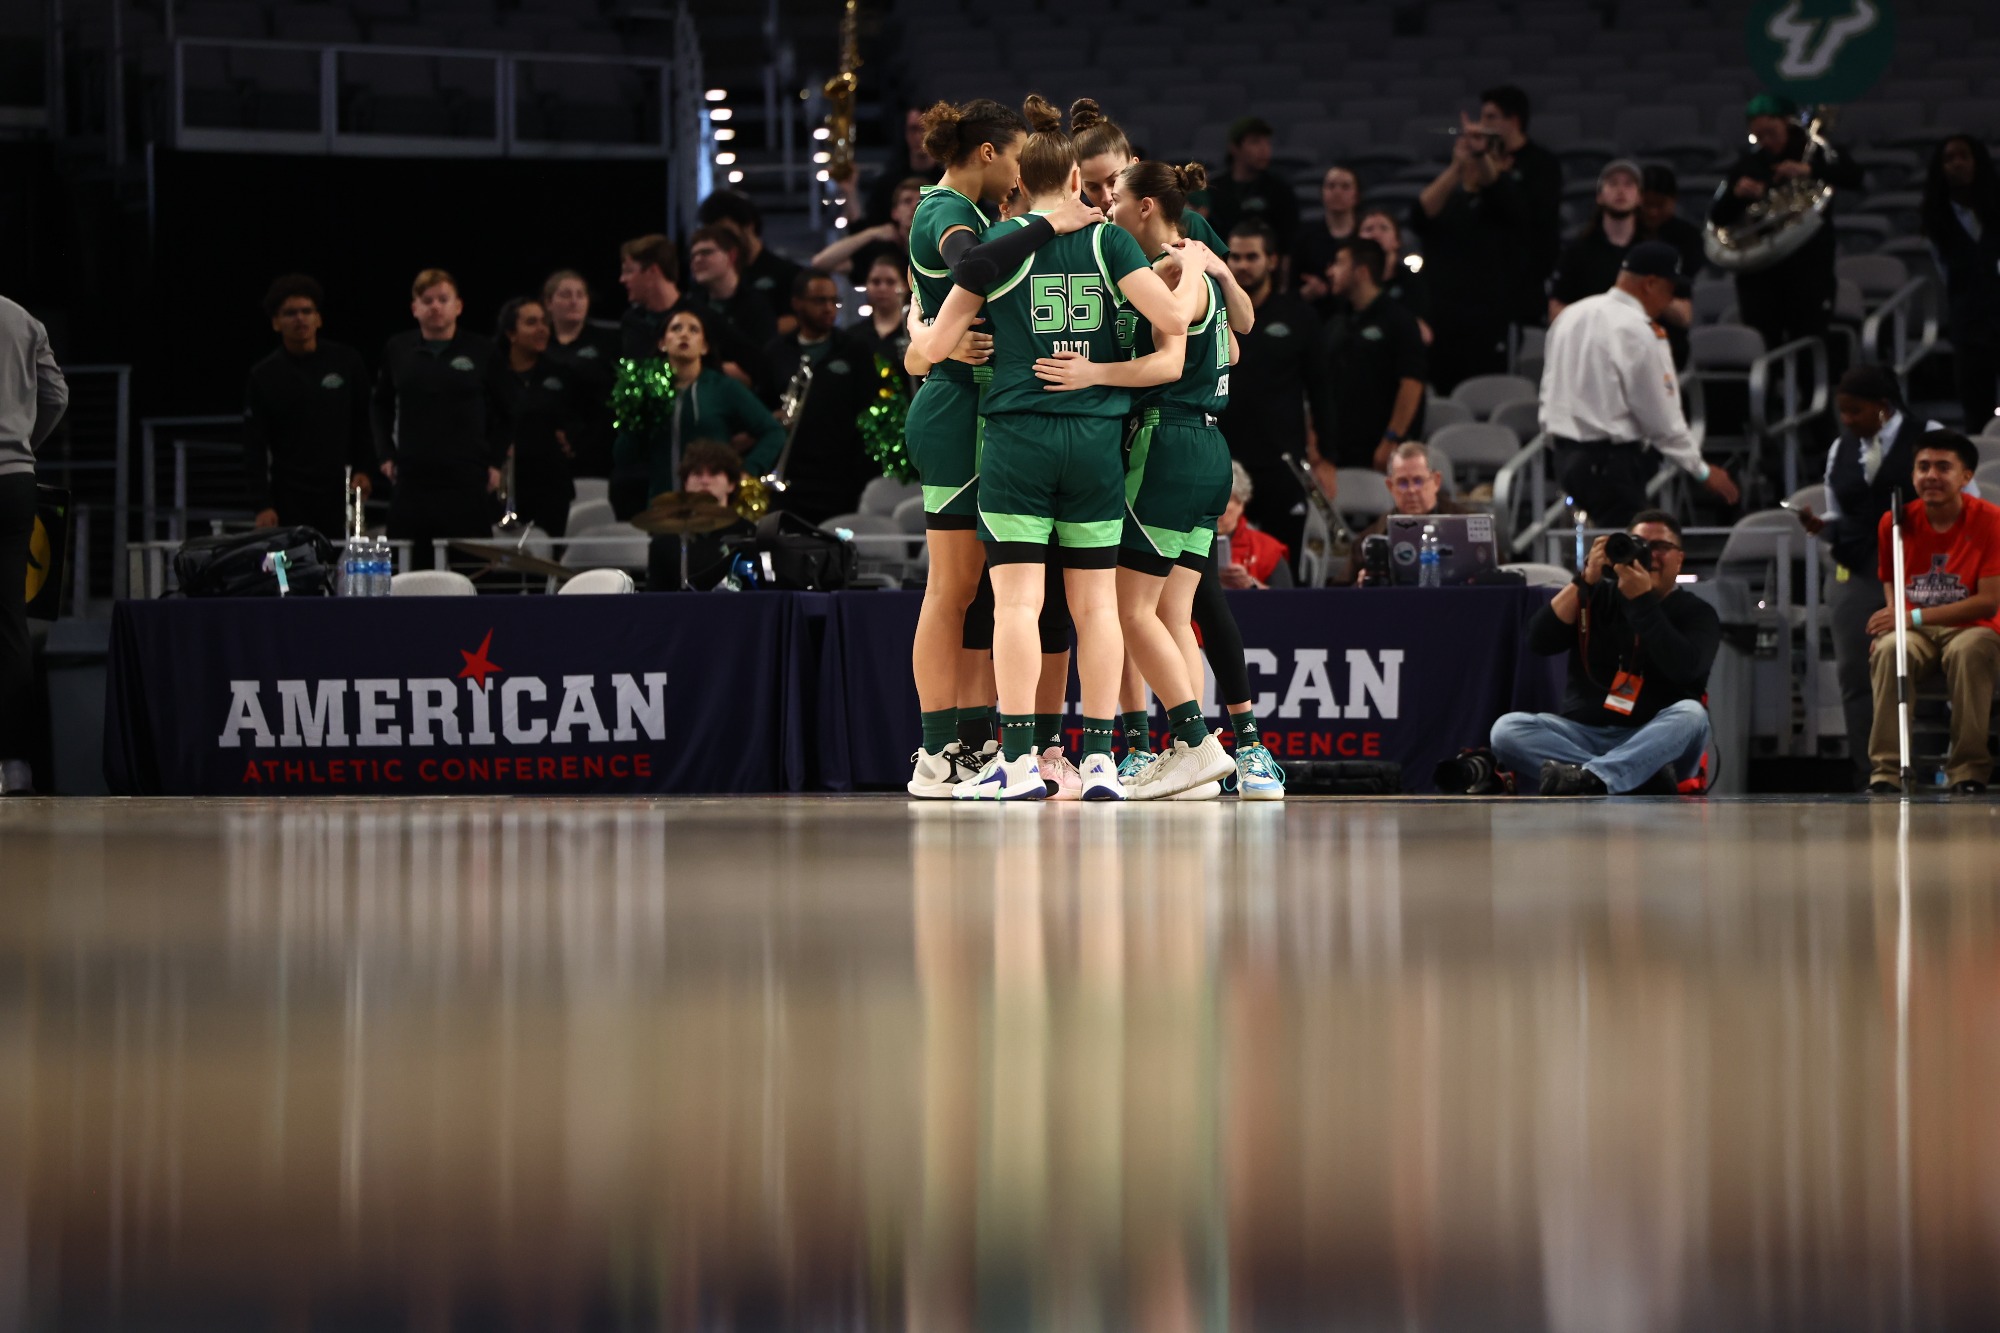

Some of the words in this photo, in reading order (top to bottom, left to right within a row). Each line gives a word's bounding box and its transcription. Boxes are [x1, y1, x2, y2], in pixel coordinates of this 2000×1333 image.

[1030, 273, 1104, 333] 55
[218, 672, 668, 747] AMERICAN
[242, 758, 403, 784] ATHLETIC
[418, 754, 653, 782] CONFERENCE
